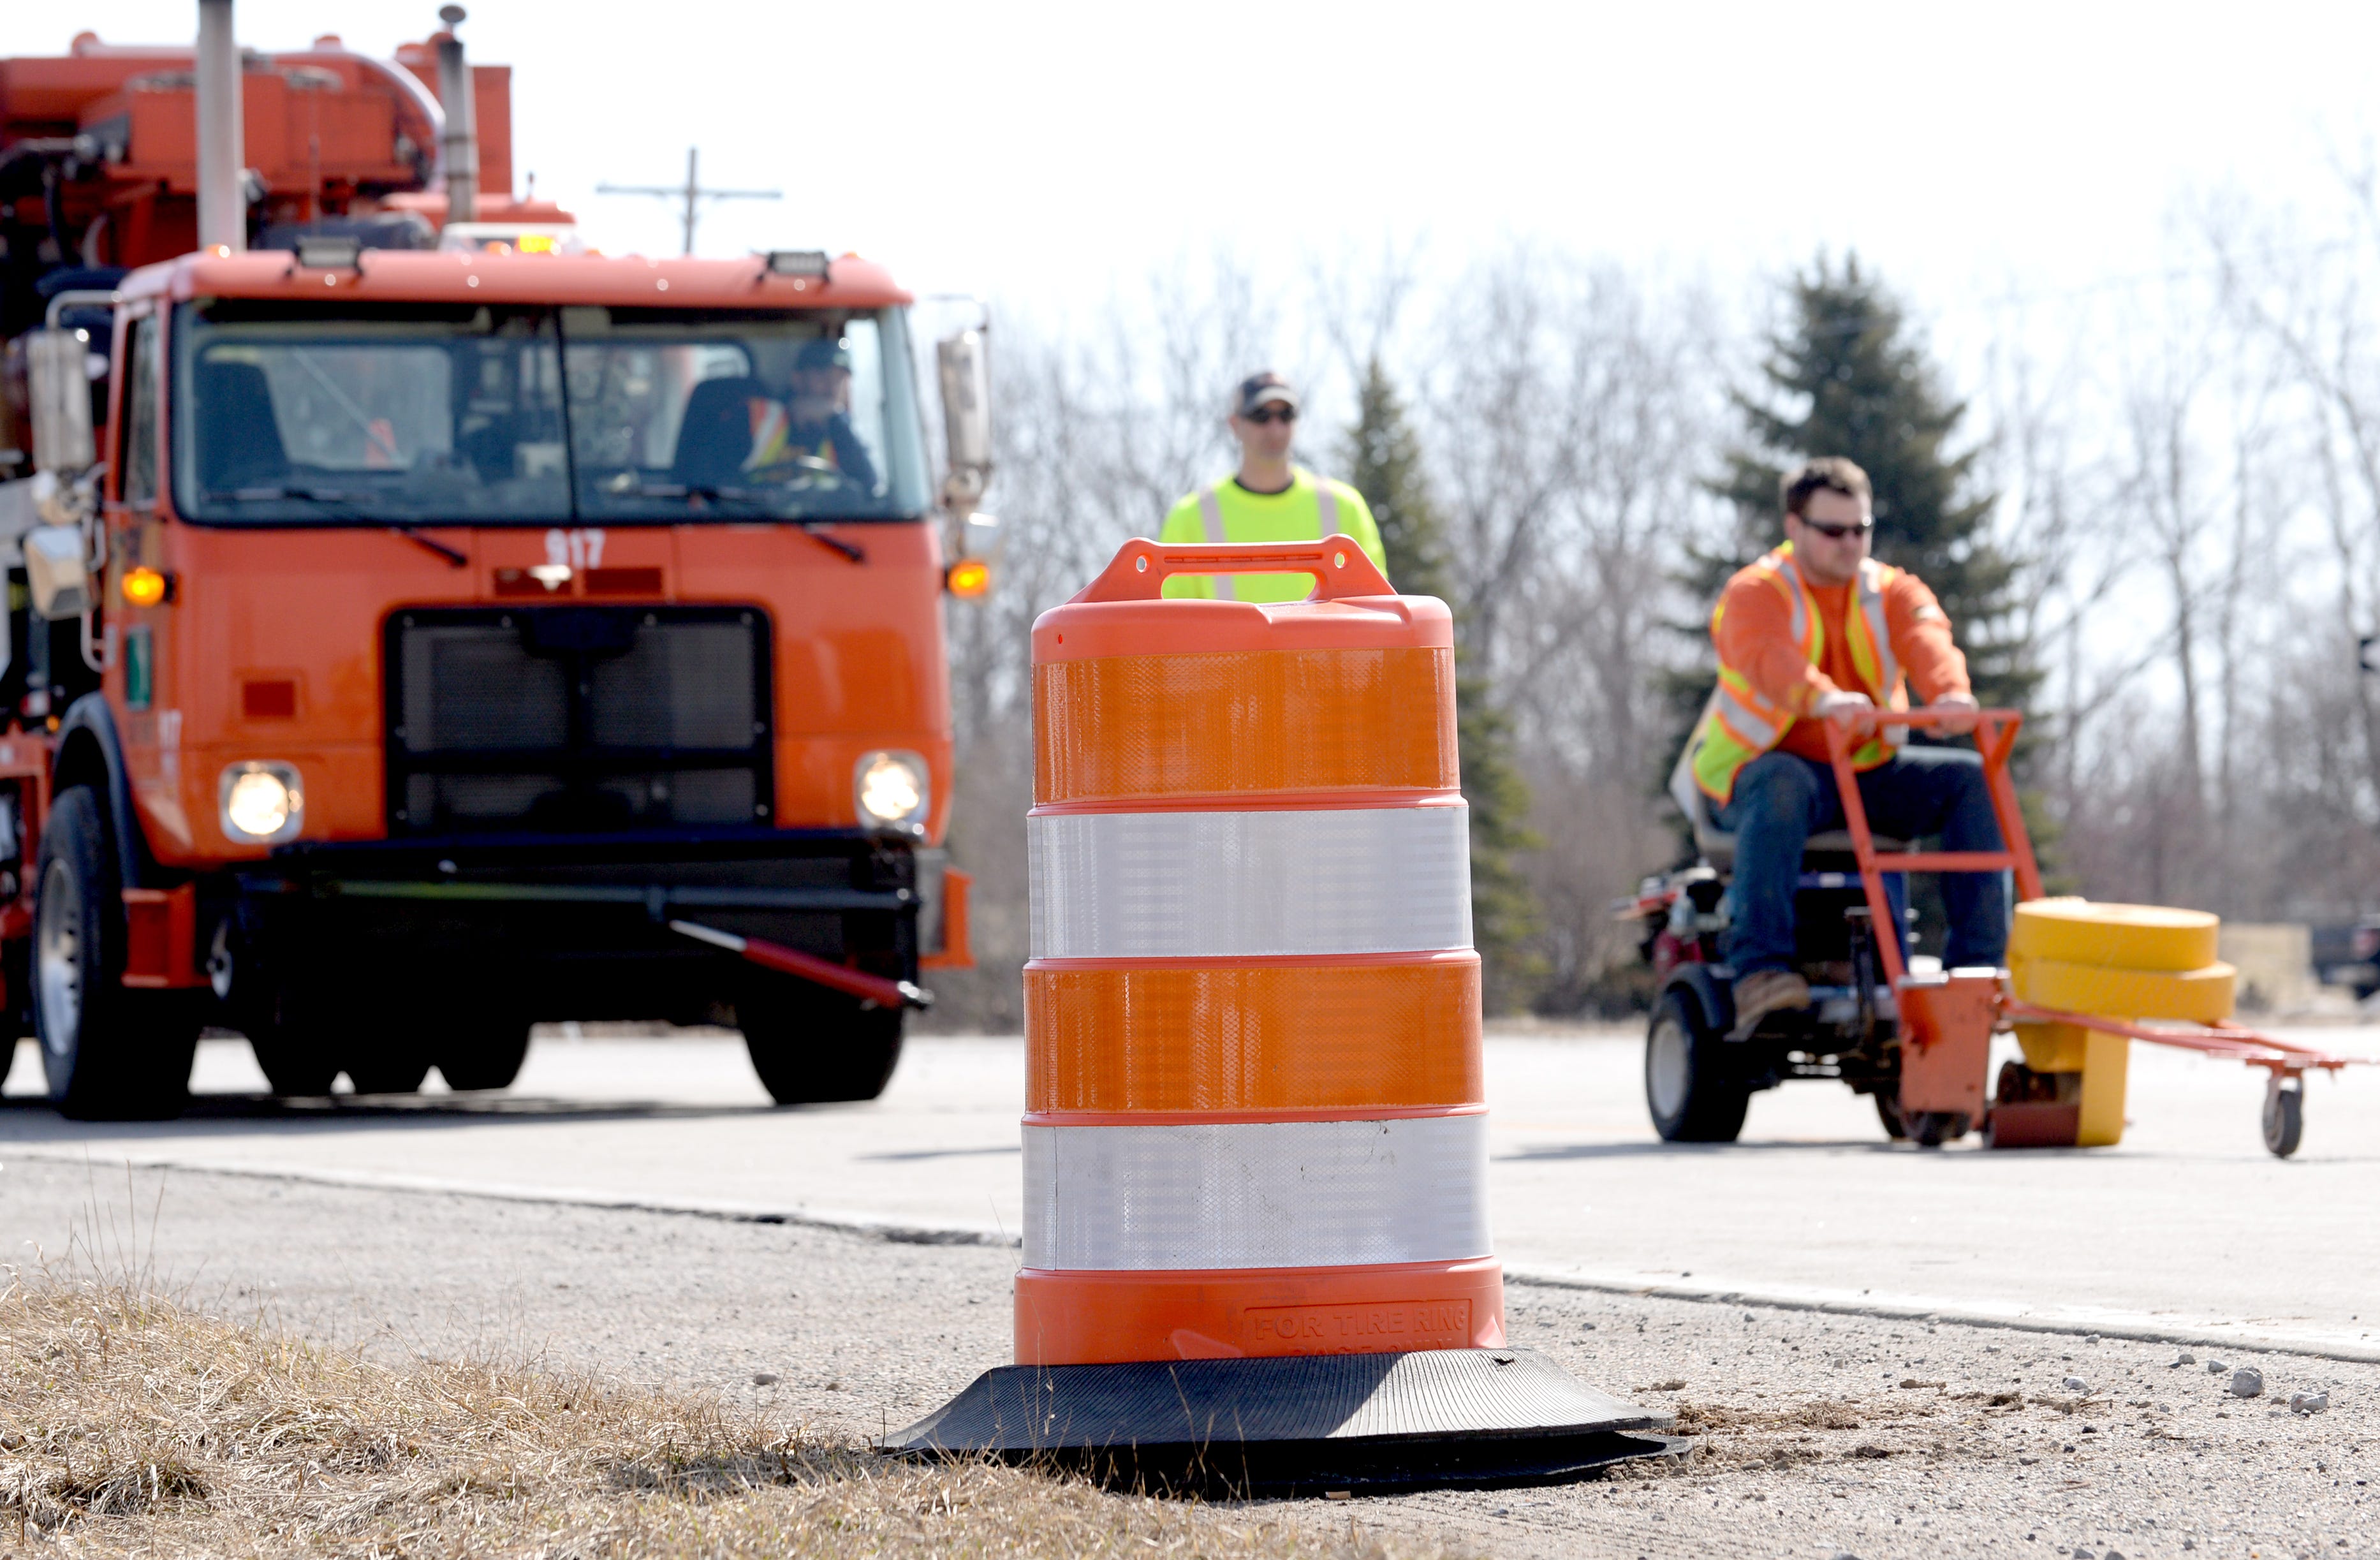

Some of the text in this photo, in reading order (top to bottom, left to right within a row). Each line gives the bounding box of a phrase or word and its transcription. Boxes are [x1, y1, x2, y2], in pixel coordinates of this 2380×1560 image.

[545, 529, 605, 568] 917
[1255, 1306, 1466, 1340] FOR TIRE RING
